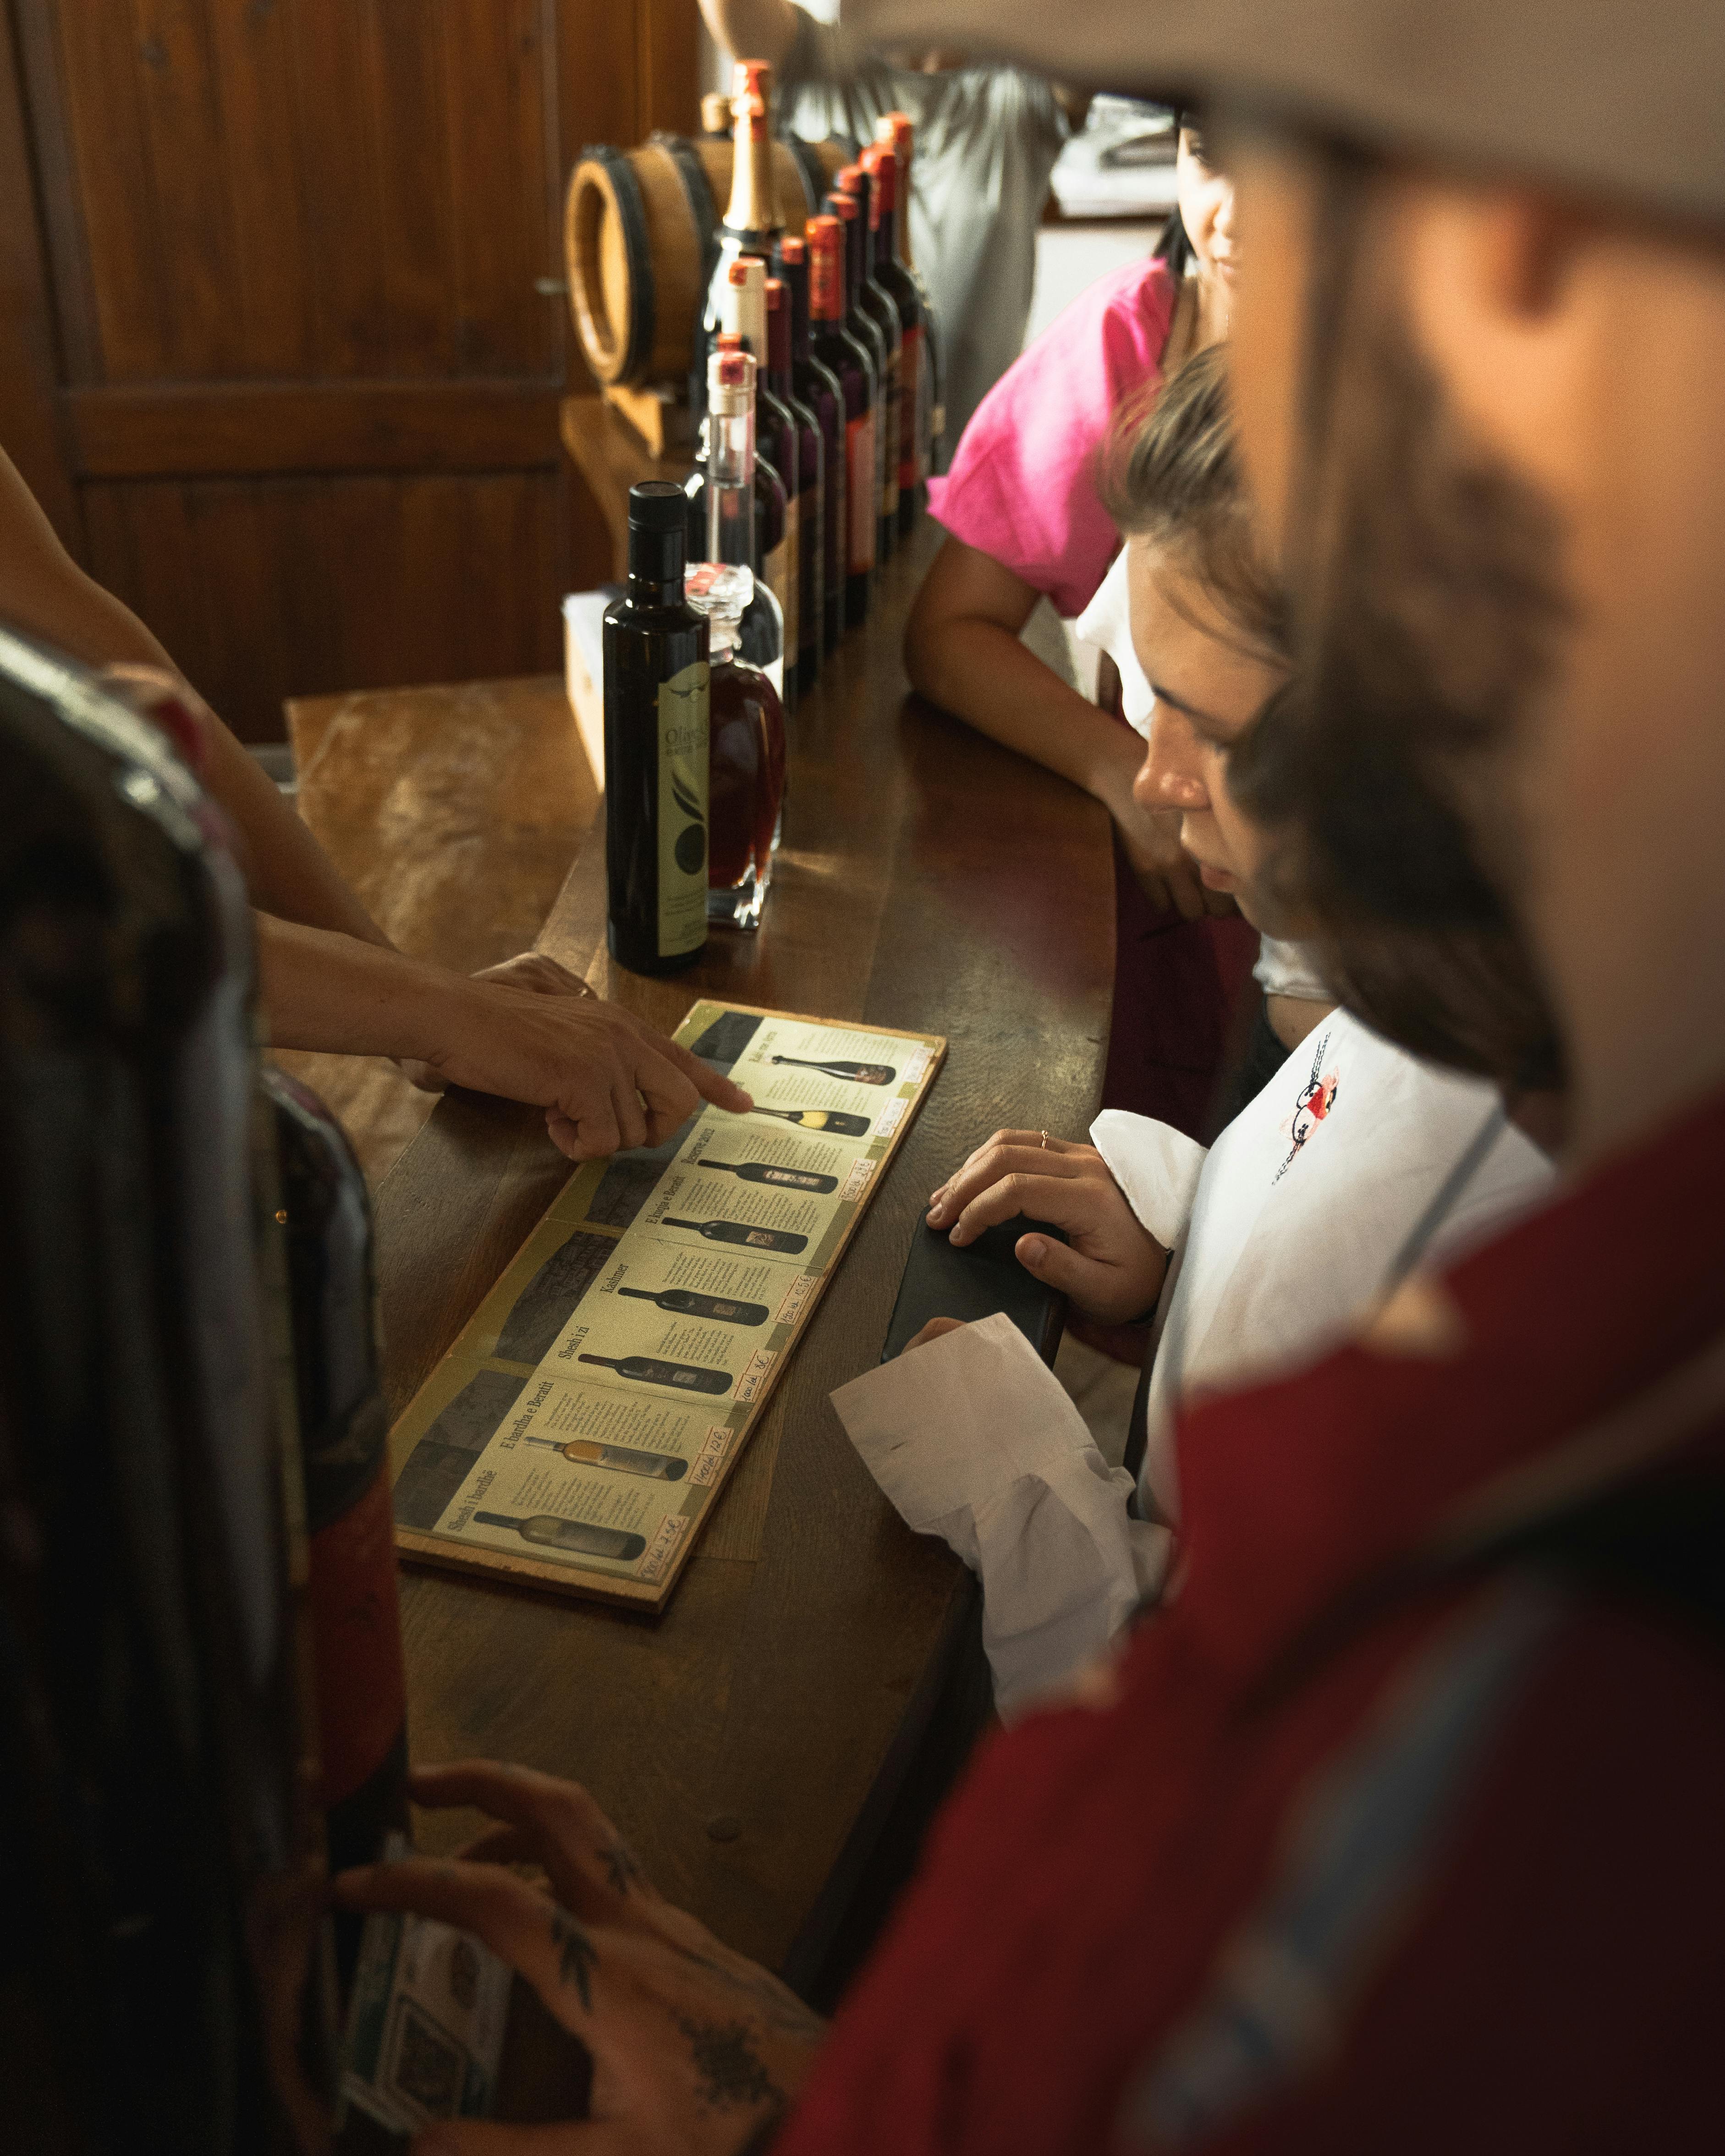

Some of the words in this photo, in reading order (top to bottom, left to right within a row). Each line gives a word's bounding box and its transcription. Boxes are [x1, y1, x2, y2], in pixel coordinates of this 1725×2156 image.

[663, 1176, 685, 1196] Beratit
[600, 1263, 629, 1294] Kashmer
[558, 1339, 582, 1360] Shesh
[576, 1326, 590, 1334] zi
[503, 1414, 533, 1442] bardha
[527, 1381, 555, 1407] Beratit
[447, 1506, 475, 1531] Shesh
[466, 1469, 498, 1501] bardhë
